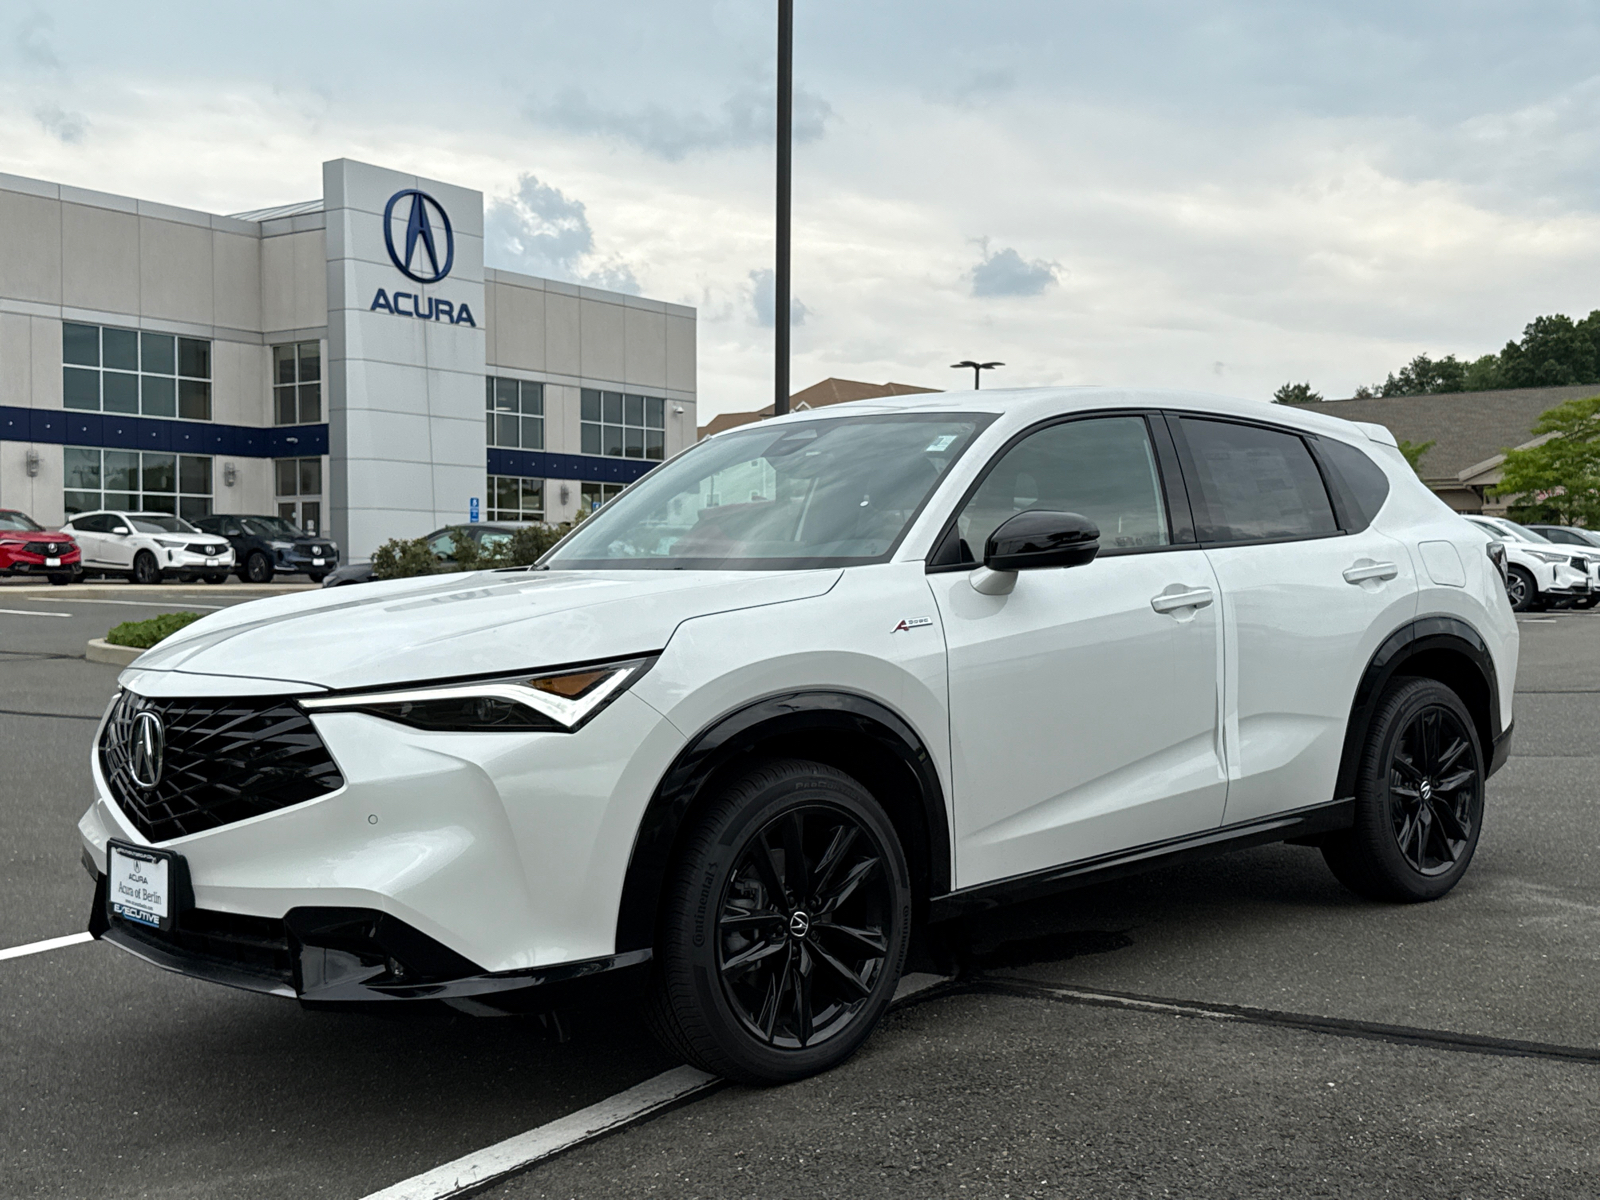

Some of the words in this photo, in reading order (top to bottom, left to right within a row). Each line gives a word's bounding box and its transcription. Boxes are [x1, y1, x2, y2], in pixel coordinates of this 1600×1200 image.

[370, 287, 477, 328] ACURA
[128, 873, 148, 884] ACURA
[118, 881, 134, 897] Acura
[135, 888, 141, 899] of
[143, 888, 162, 905] Berlin
[114, 904, 159, 924] EXECUTIVE
[692, 871, 715, 947] Continental
